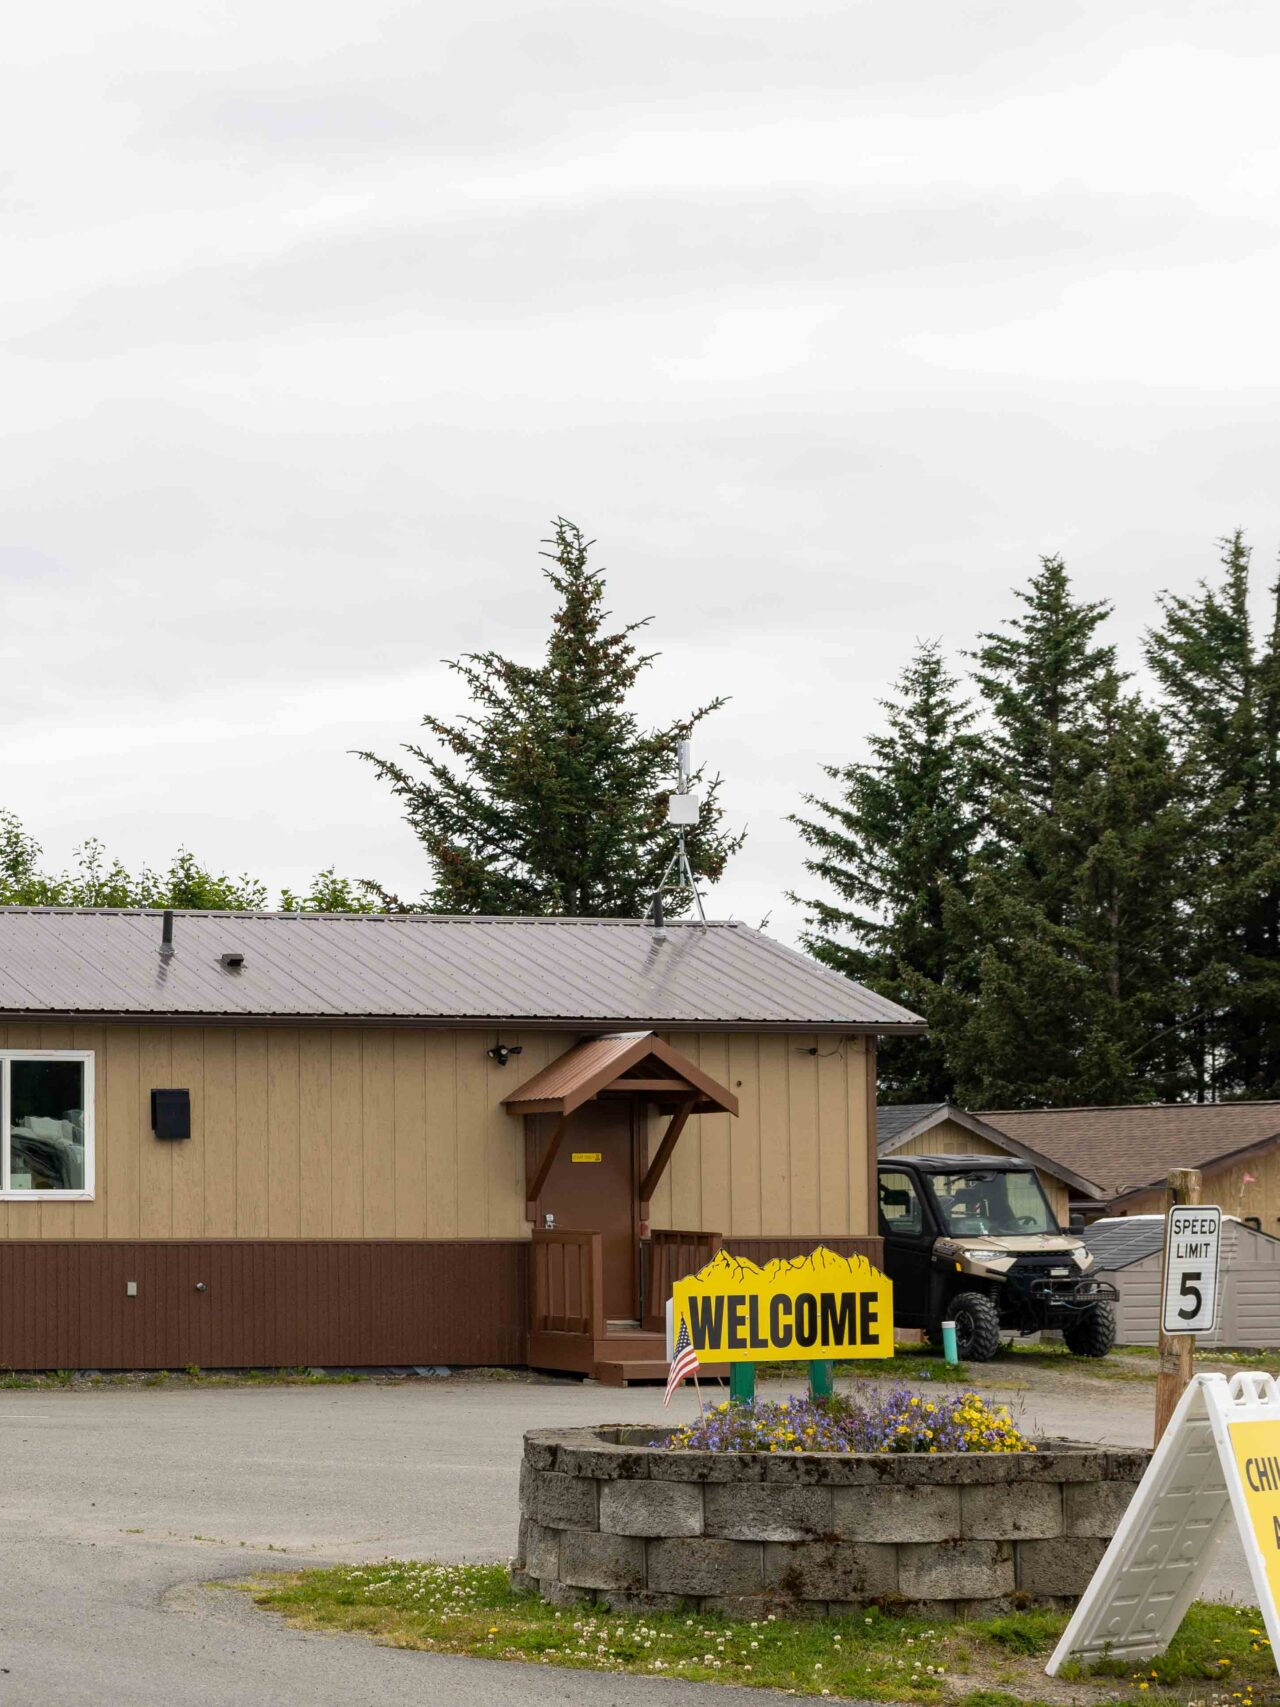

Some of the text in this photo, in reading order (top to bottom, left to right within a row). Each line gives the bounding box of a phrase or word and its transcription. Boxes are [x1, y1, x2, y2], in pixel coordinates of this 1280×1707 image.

[1173, 1219, 1217, 1235] SPEED
[1176, 1243, 1211, 1259] LIMIT
[1177, 1272, 1203, 1321] 5
[688, 1292, 880, 1350] WELCOME
